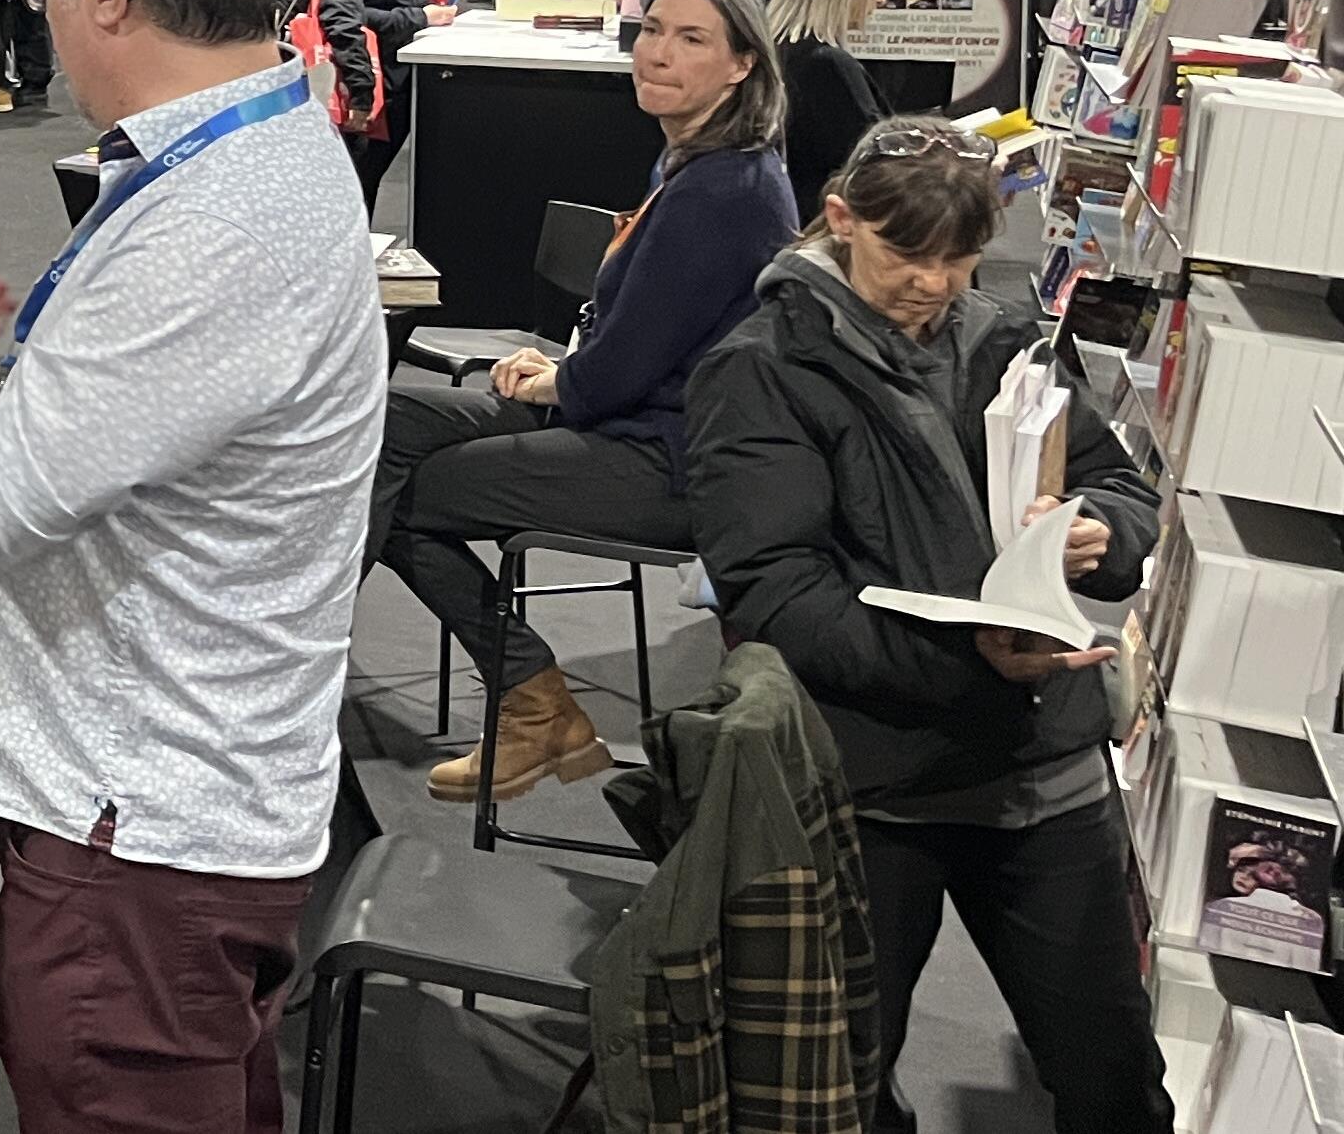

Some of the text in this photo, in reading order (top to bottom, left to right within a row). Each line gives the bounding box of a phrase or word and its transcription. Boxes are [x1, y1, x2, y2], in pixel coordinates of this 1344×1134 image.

[887, 36, 900, 45] LE
[902, 36, 954, 46] MURMURE
[955, 37, 980, 46] D'UN
[982, 37, 1000, 47] CRI
